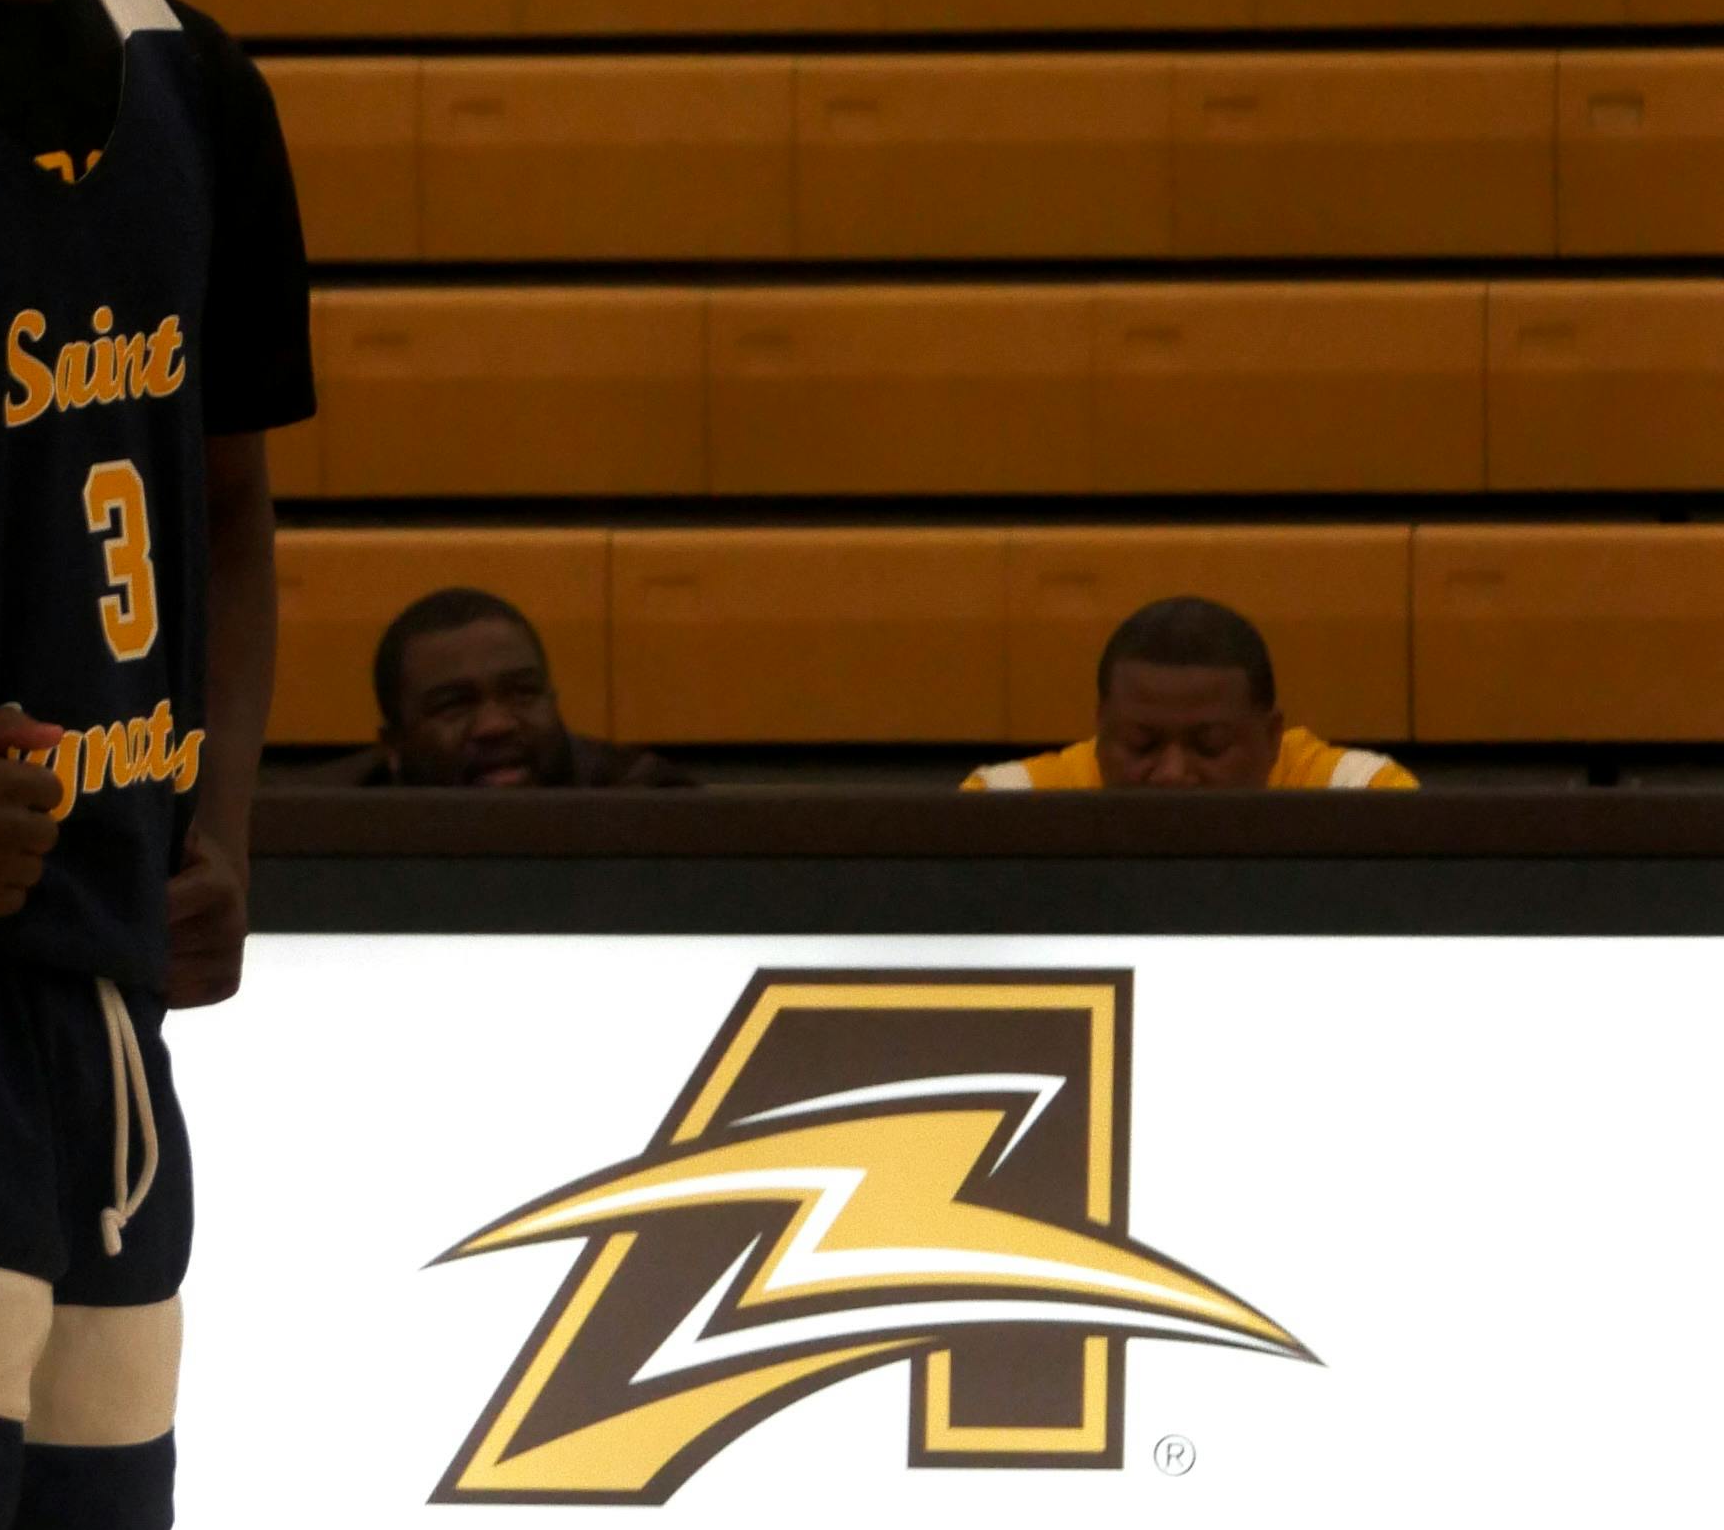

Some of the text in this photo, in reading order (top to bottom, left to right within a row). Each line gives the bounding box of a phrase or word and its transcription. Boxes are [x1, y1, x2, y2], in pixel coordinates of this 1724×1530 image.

[4, 305, 185, 427] Saint
[83, 459, 158, 662] 3
[0, 697, 206, 822] gnats
